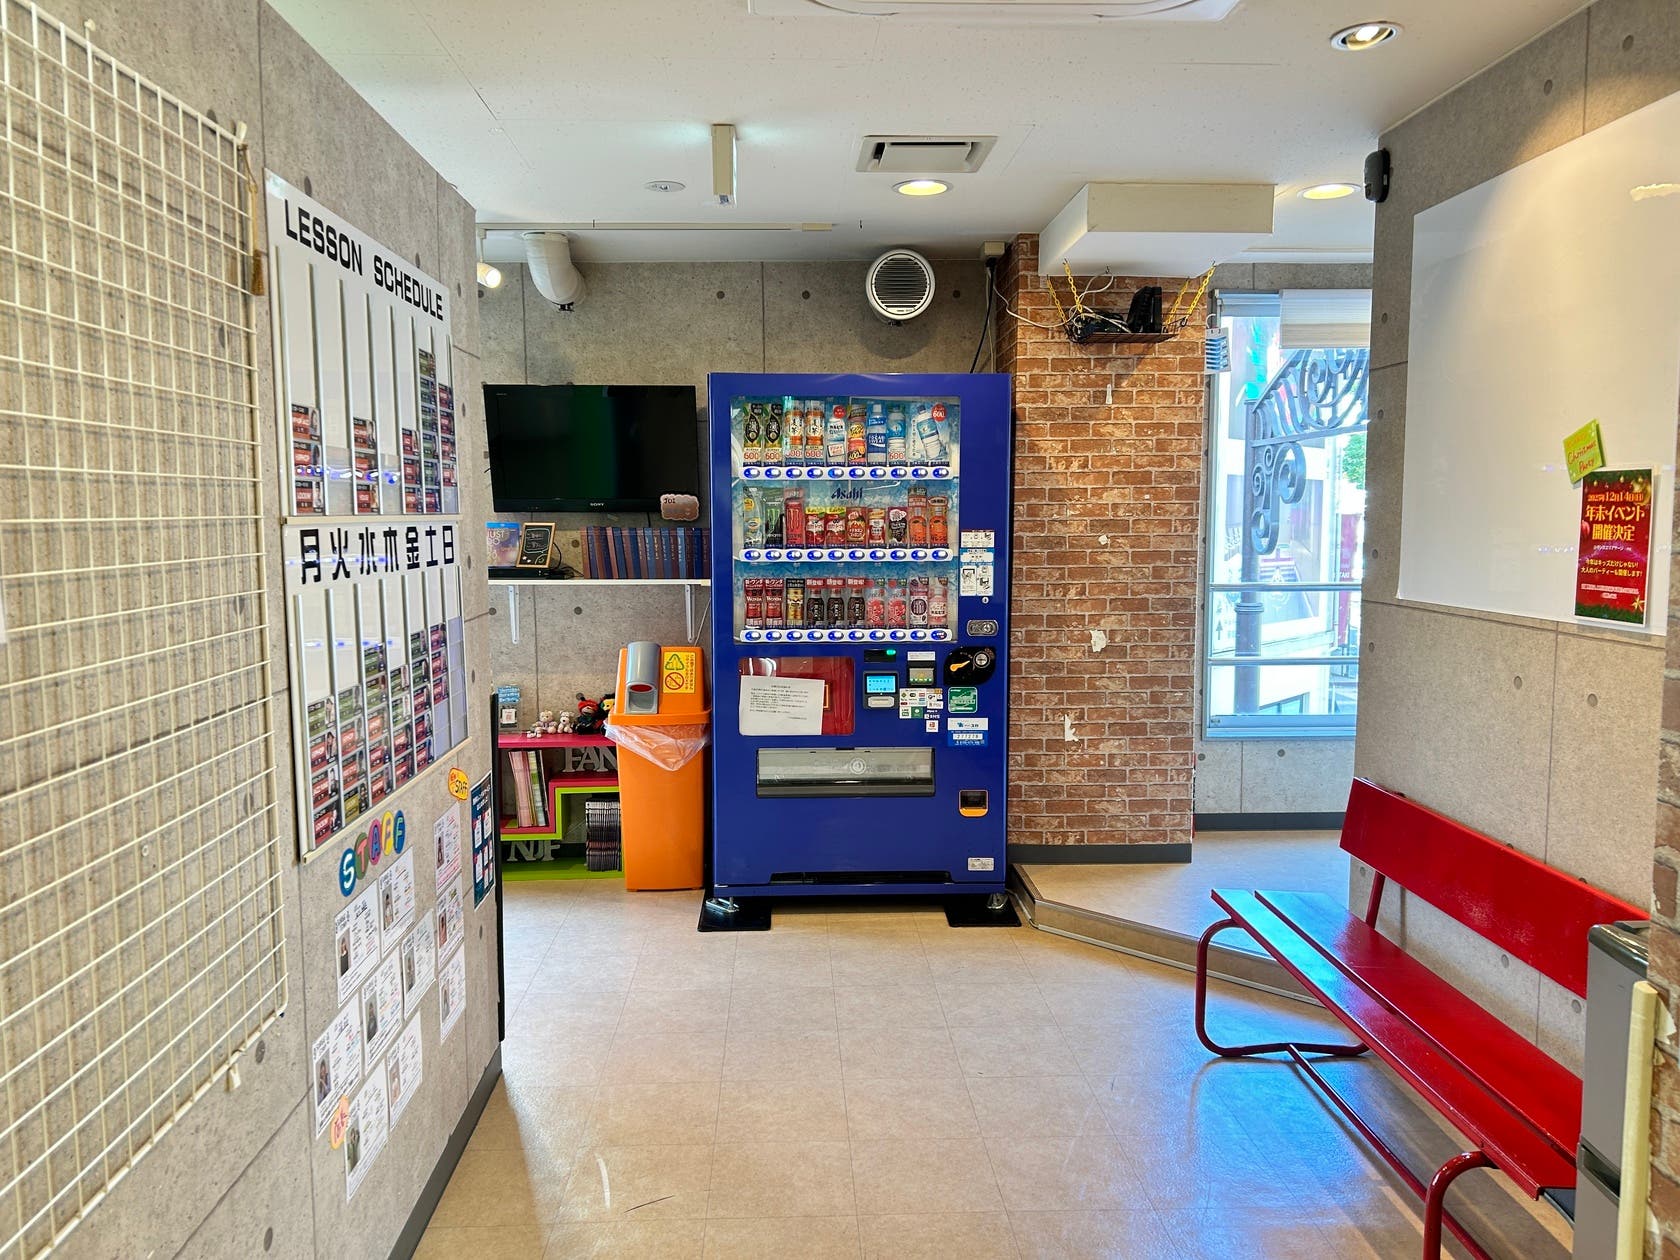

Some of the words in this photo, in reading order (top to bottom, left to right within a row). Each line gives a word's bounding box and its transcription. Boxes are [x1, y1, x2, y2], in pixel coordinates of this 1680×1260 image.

[285, 198, 363, 276] LESSON
[374, 255, 444, 321] SCHEDULE
[831, 487, 863, 500] Asahi
[1585, 505, 1645, 522] 年末イベント
[1592, 523, 1636, 541] 開催決定
[342, 816, 404, 890] STAFF
